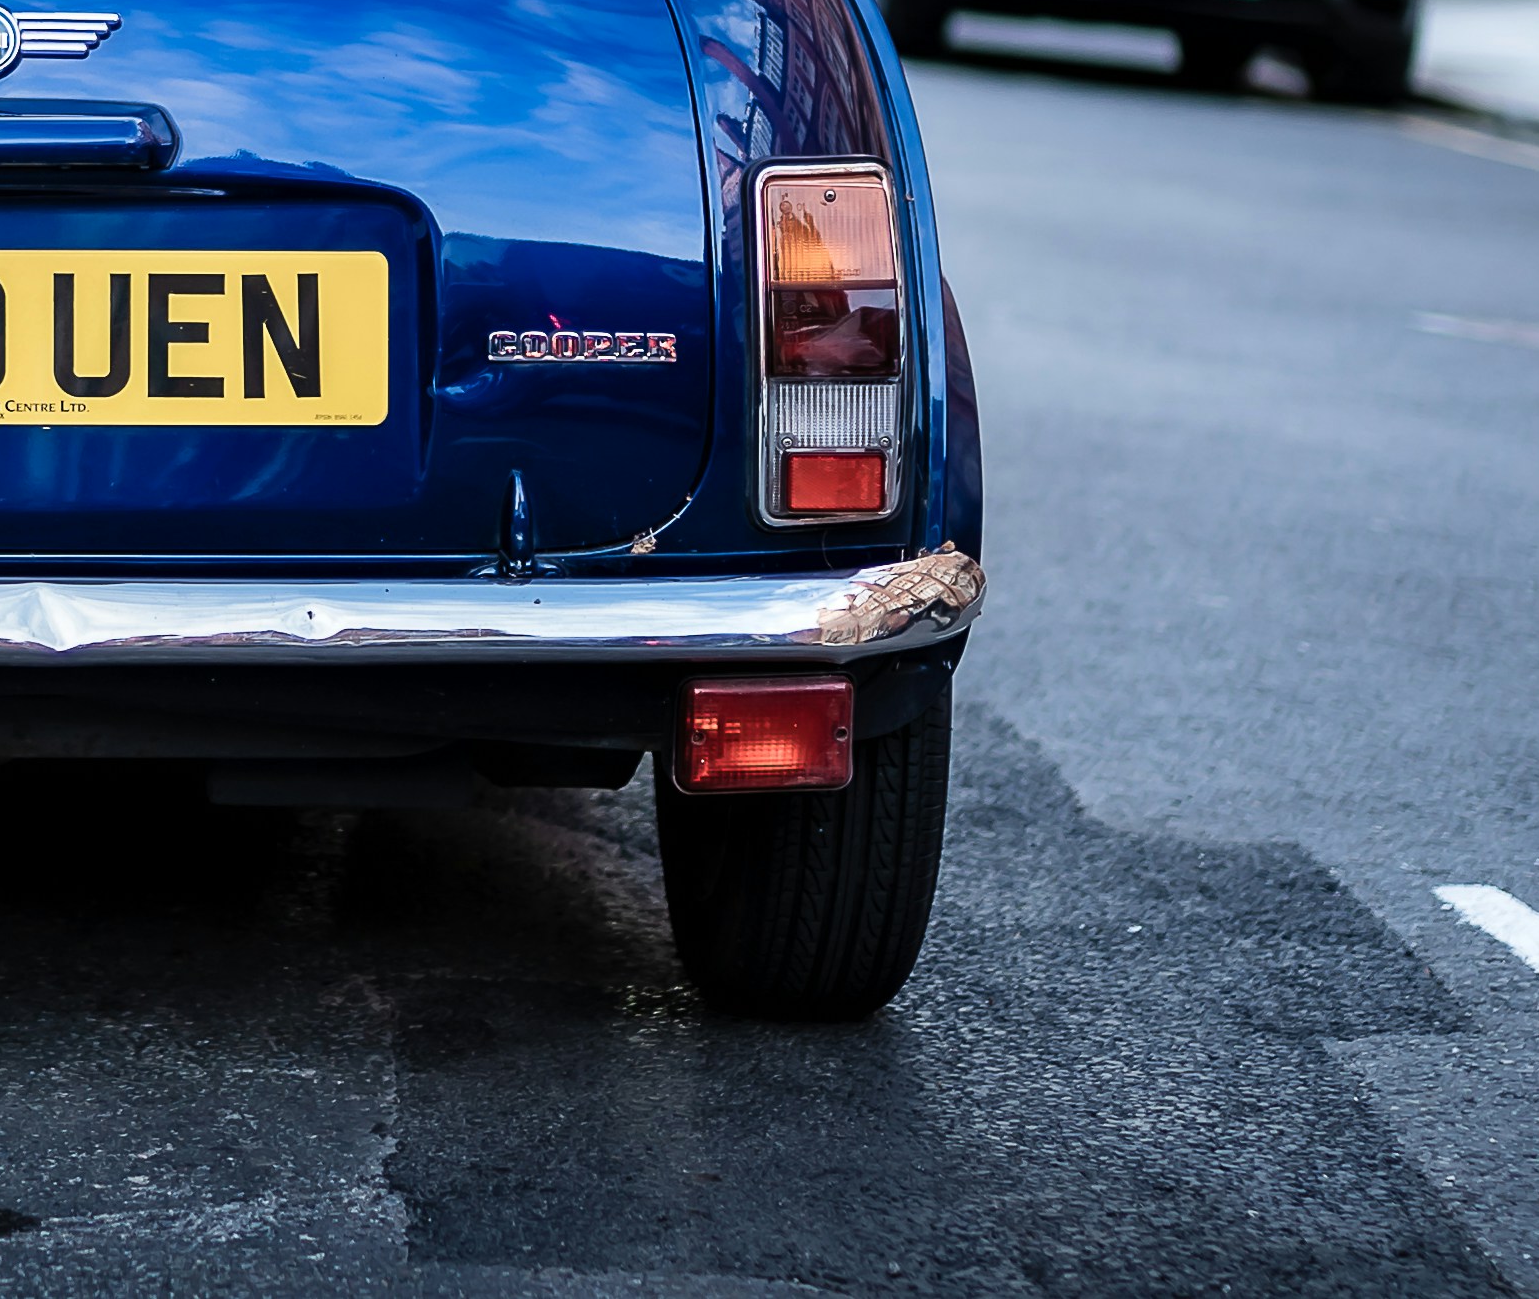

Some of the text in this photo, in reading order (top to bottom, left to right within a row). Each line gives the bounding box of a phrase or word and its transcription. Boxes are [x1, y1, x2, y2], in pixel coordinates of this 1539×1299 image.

[52, 271, 324, 399] UEN
[488, 330, 677, 363] COOPER
[4, 399, 56, 413] CENTRE
